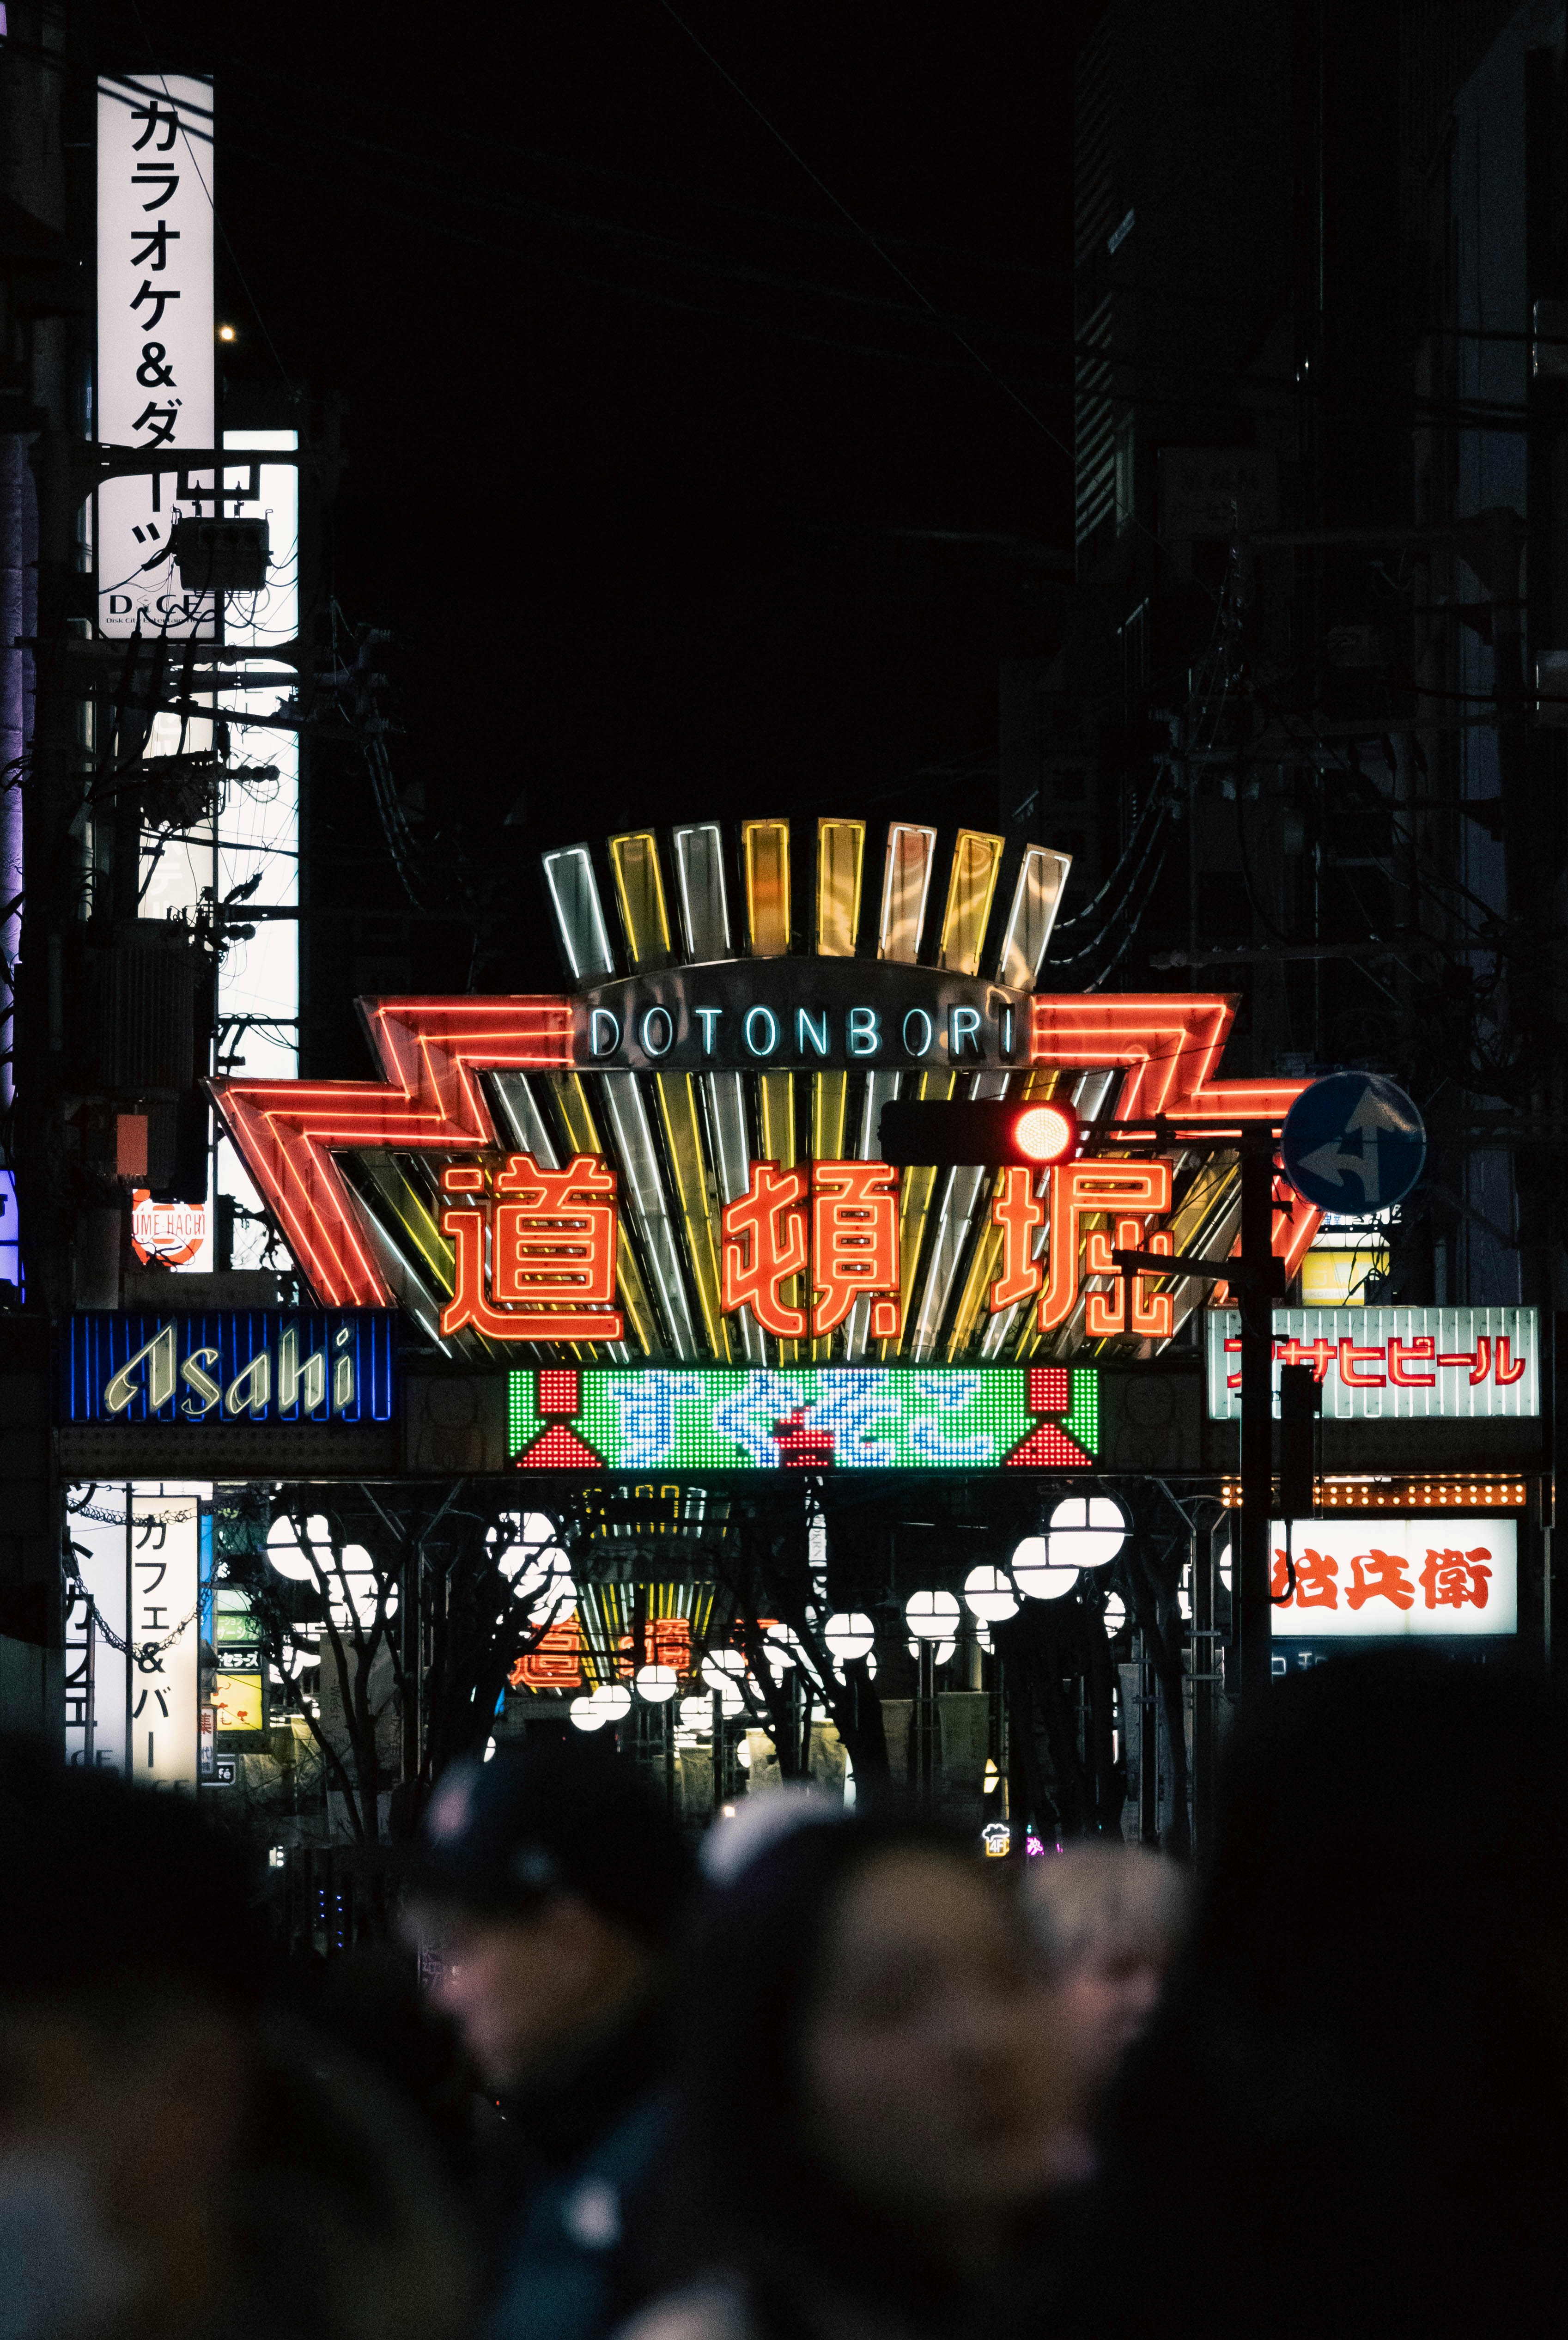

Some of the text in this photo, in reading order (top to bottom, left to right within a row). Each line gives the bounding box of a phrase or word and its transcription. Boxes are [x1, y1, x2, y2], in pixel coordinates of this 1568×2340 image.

[590, 1004, 1014, 1058] DOTONBORI
[439, 1153, 1174, 1341] 道頓堀
[104, 1317, 355, 1415] Asahi
[133, 1514, 171, 1768] カフェ&バー
[989, 1839, 1004, 1853] 4F
